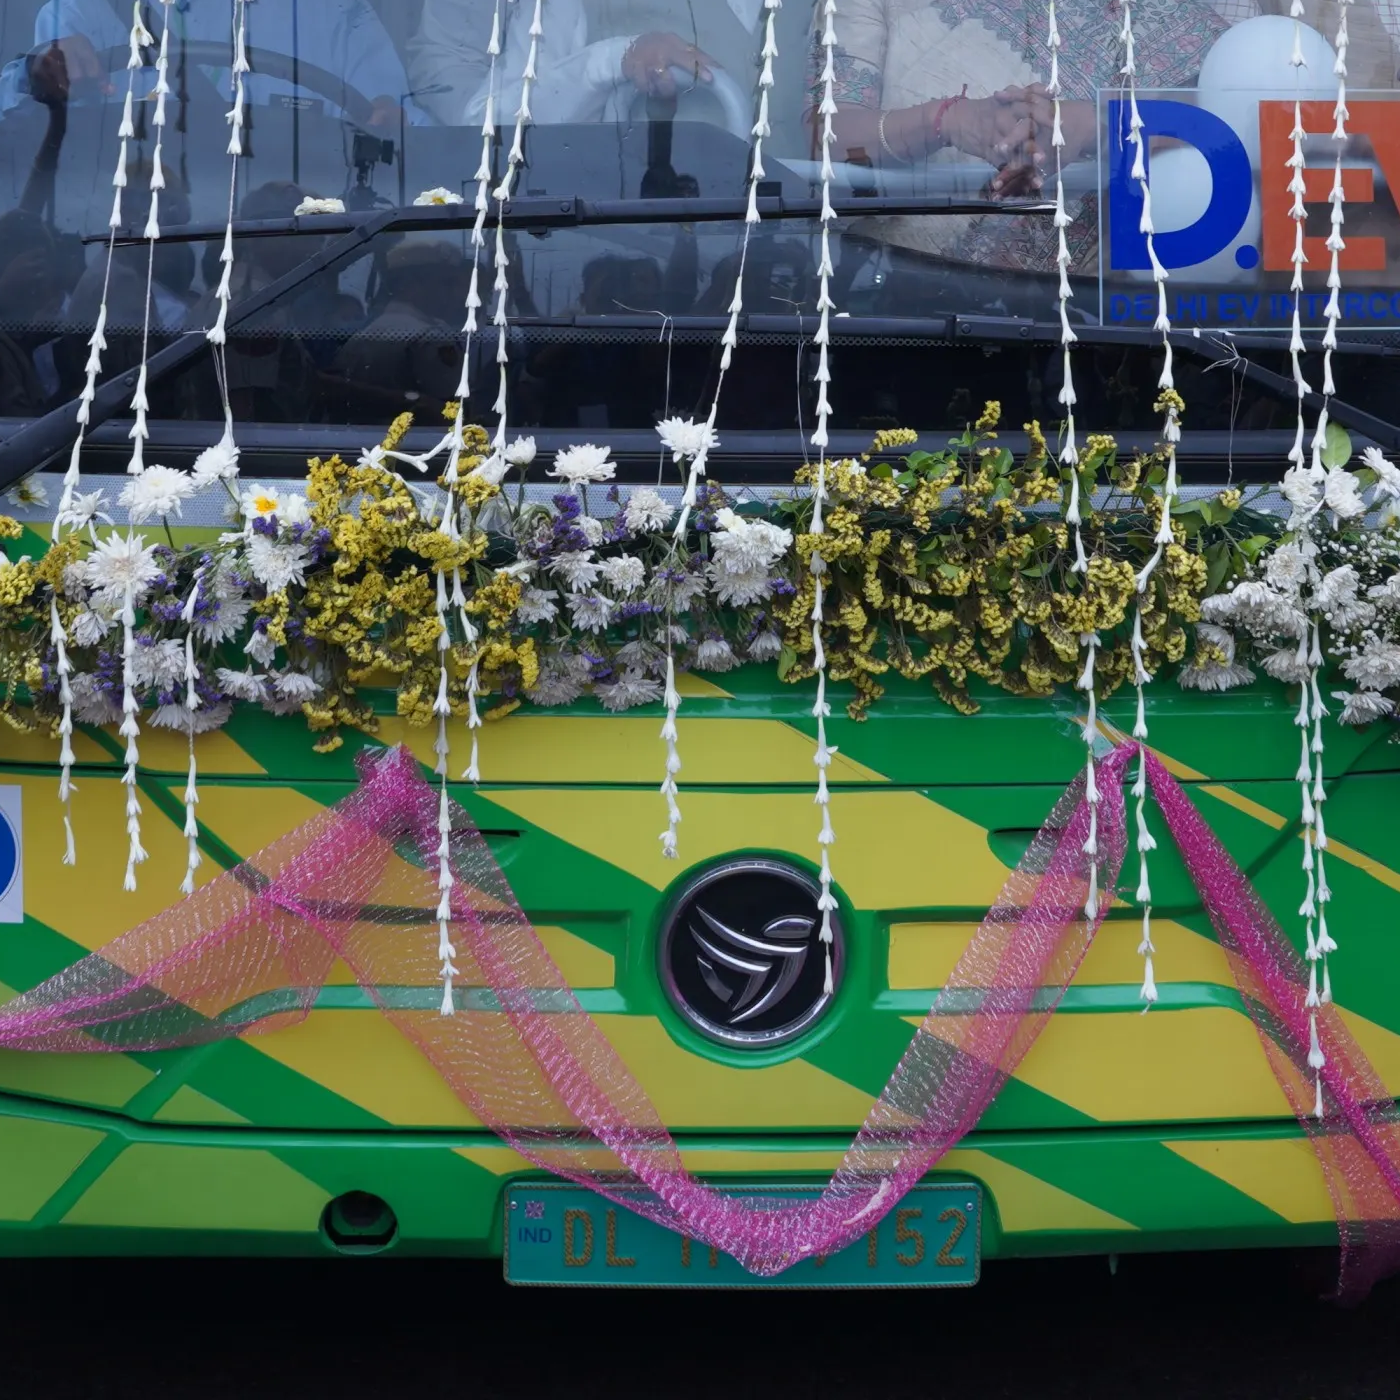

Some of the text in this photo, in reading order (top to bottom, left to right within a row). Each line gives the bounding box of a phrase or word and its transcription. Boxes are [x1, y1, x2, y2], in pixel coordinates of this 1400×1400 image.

[1218, 292, 1261, 320] EV
[518, 1227, 552, 1244] IND
[564, 1208, 636, 1267] DL
[814, 1208, 968, 1268] 152
